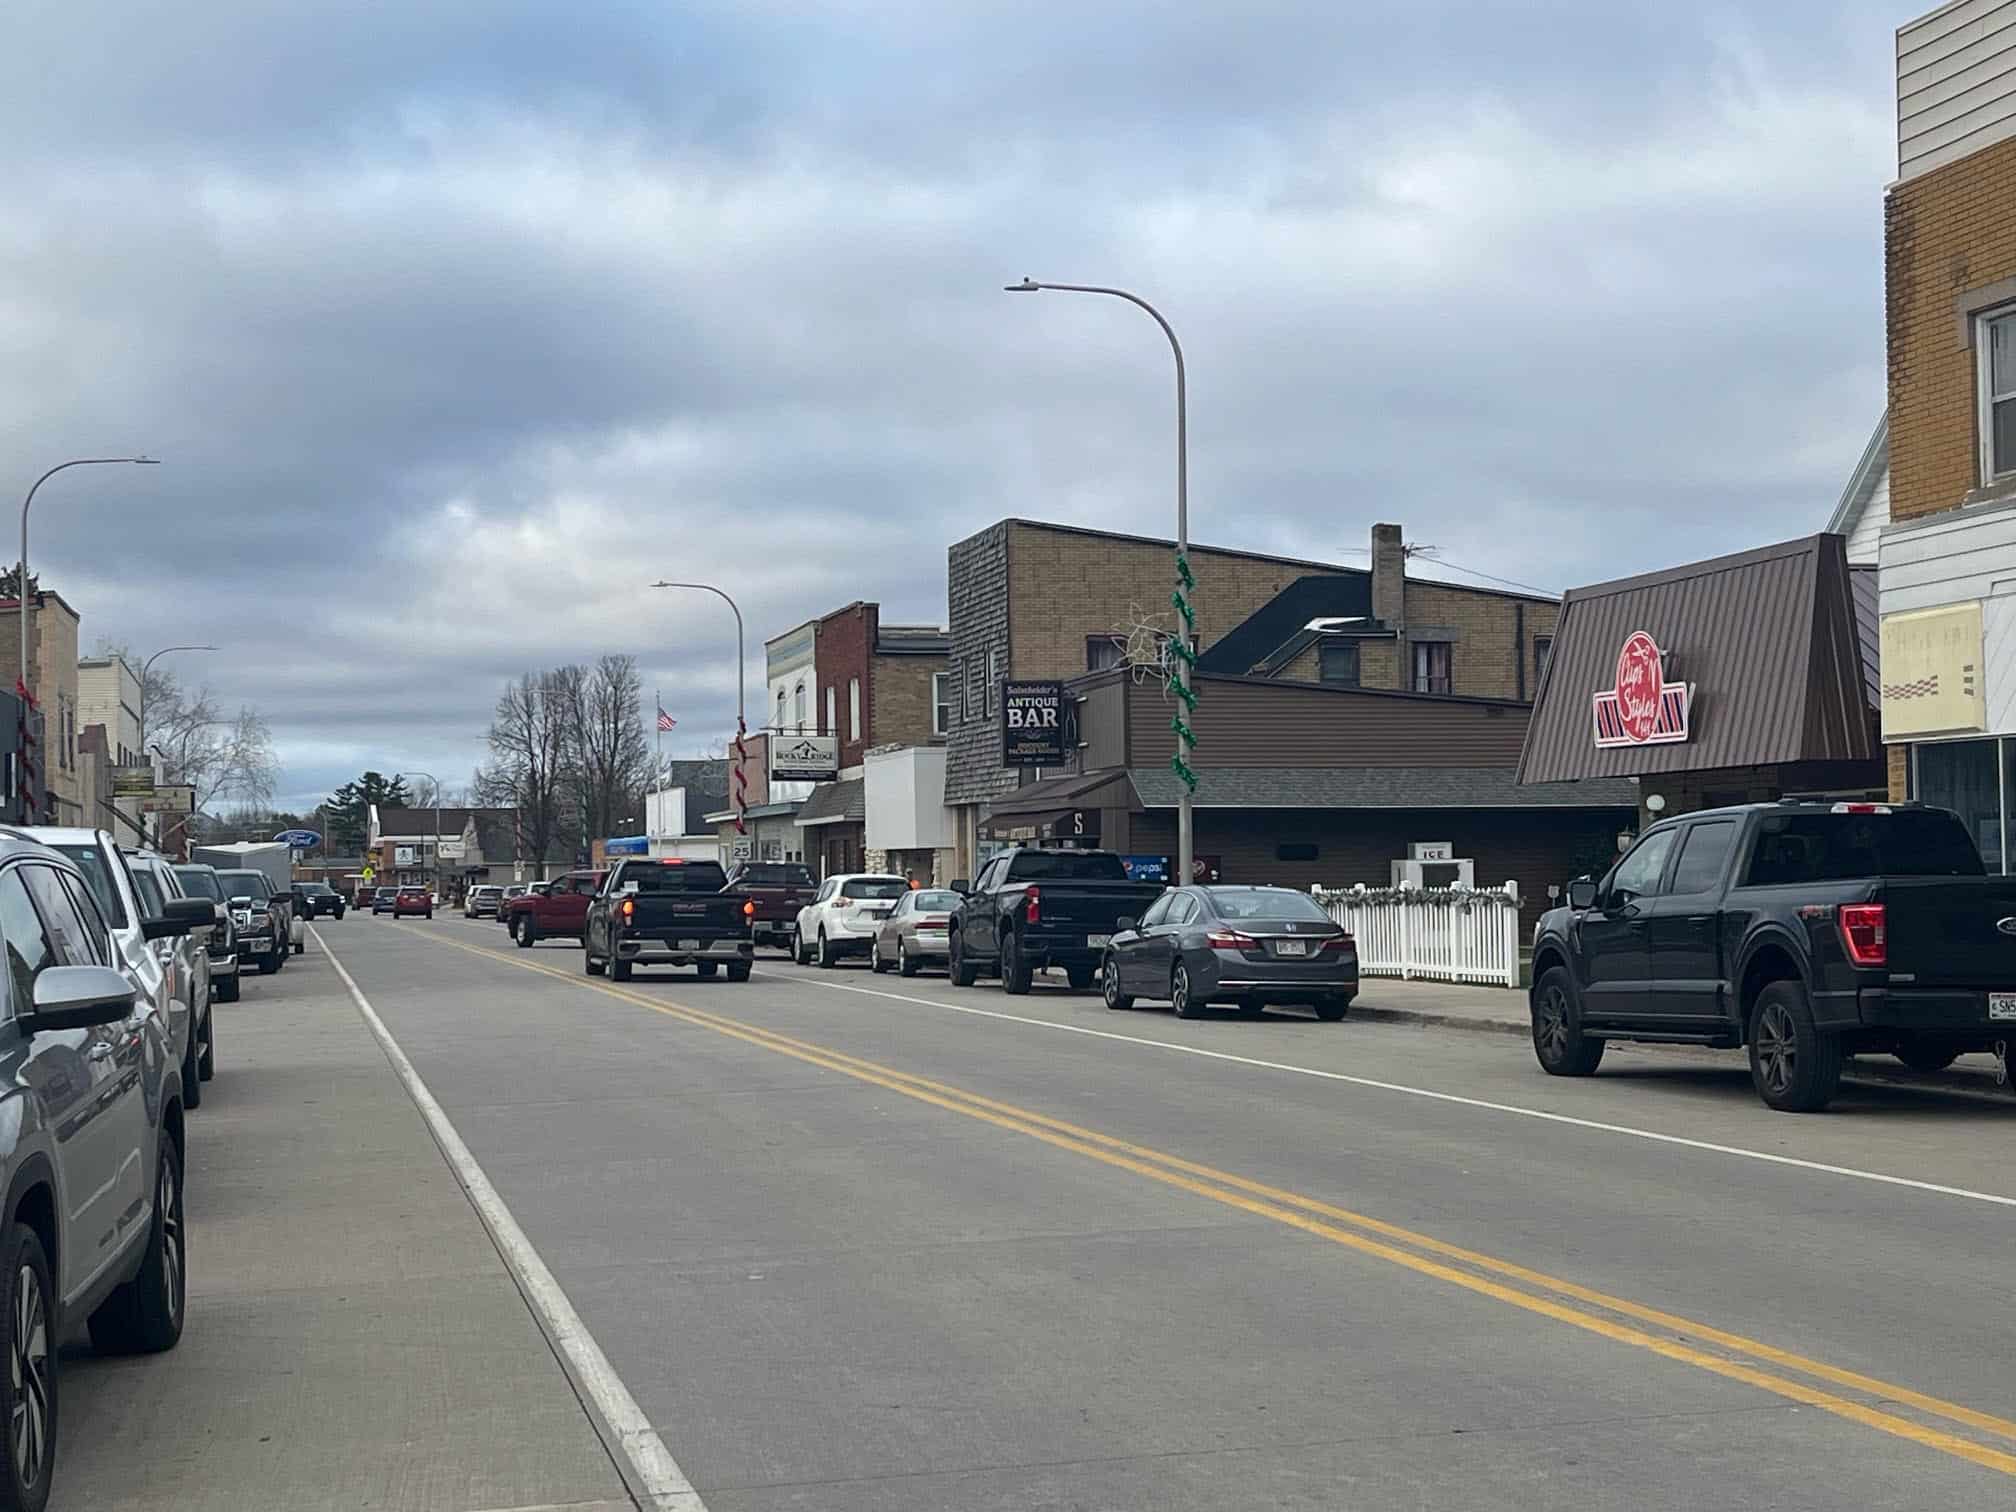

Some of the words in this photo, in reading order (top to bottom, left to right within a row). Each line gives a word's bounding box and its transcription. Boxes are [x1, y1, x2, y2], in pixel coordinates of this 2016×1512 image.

[1007, 696, 1059, 708] ANTIQUE
[1007, 708, 1059, 728] BAR
[1074, 812, 1083, 835] S
[734, 847, 750, 857] 25
[1423, 850, 1444, 859] ICE
